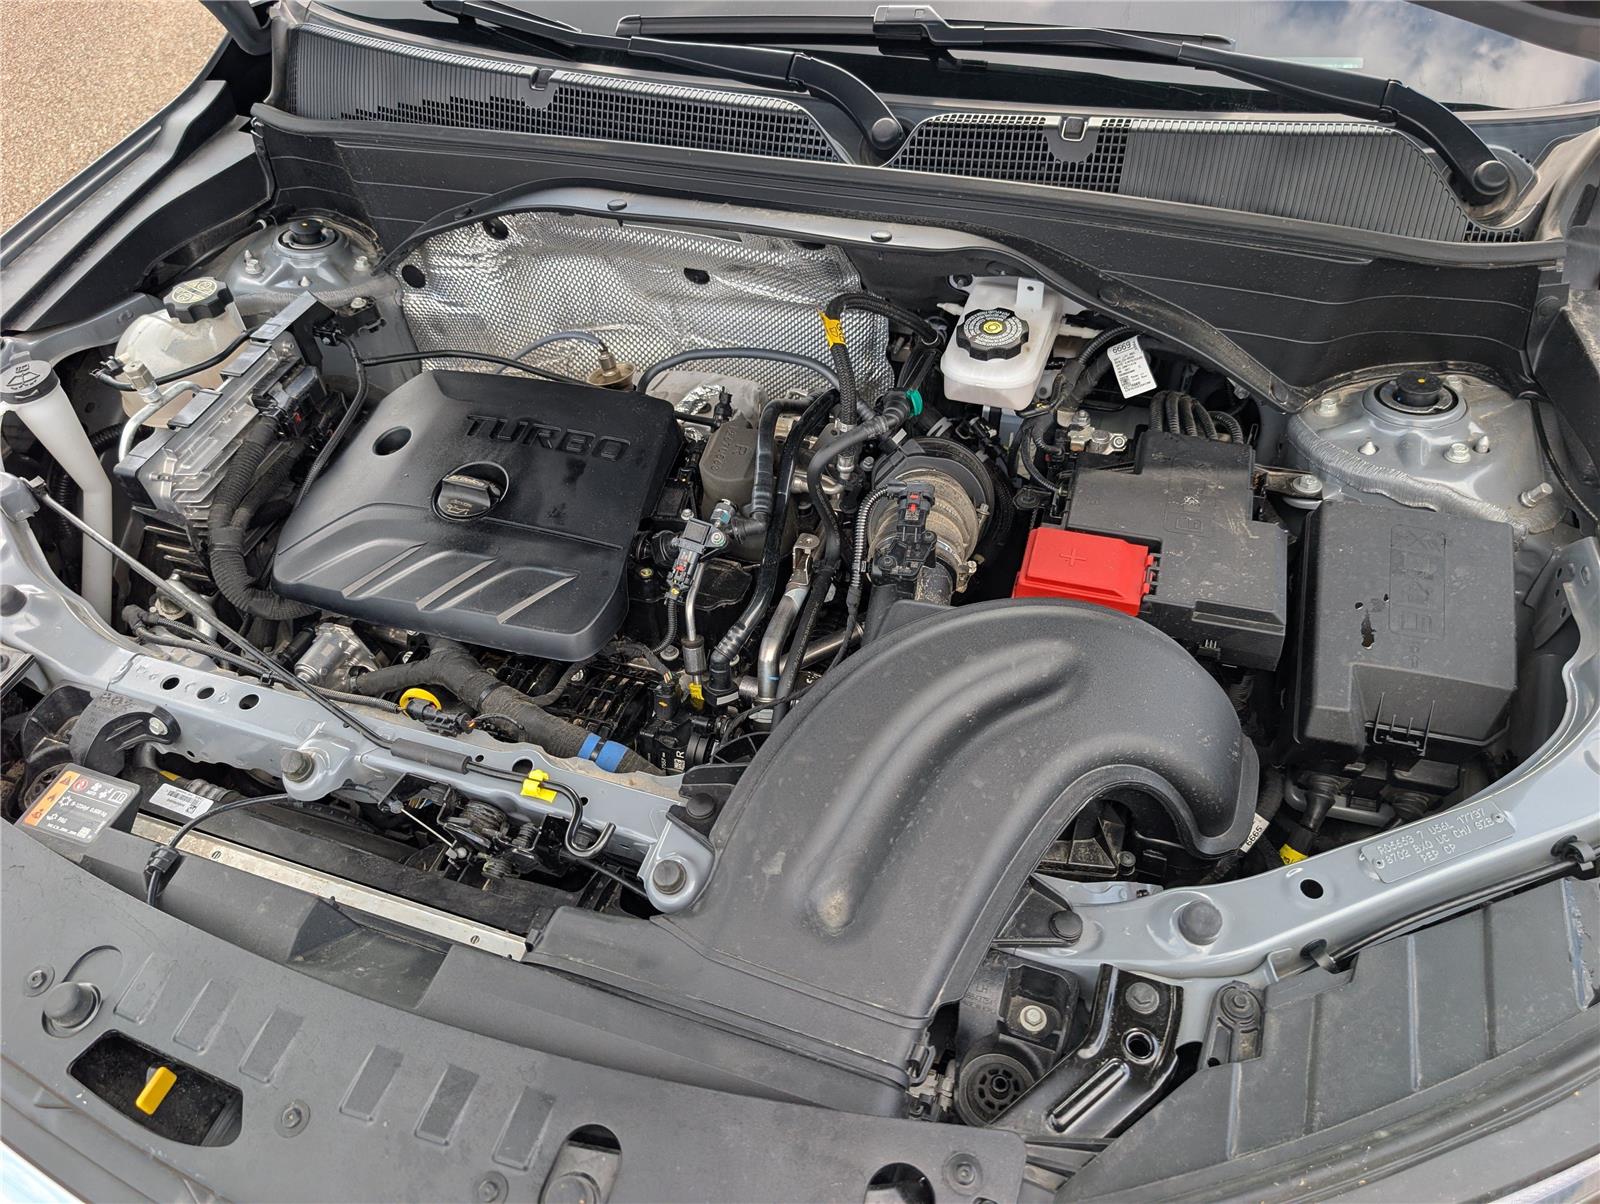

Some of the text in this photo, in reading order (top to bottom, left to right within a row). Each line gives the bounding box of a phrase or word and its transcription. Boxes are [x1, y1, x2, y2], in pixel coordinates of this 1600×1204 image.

[1112, 341, 1131, 353] 6669
[466, 413, 631, 462] TURBO
[1245, 825, 1263, 846] 6665
